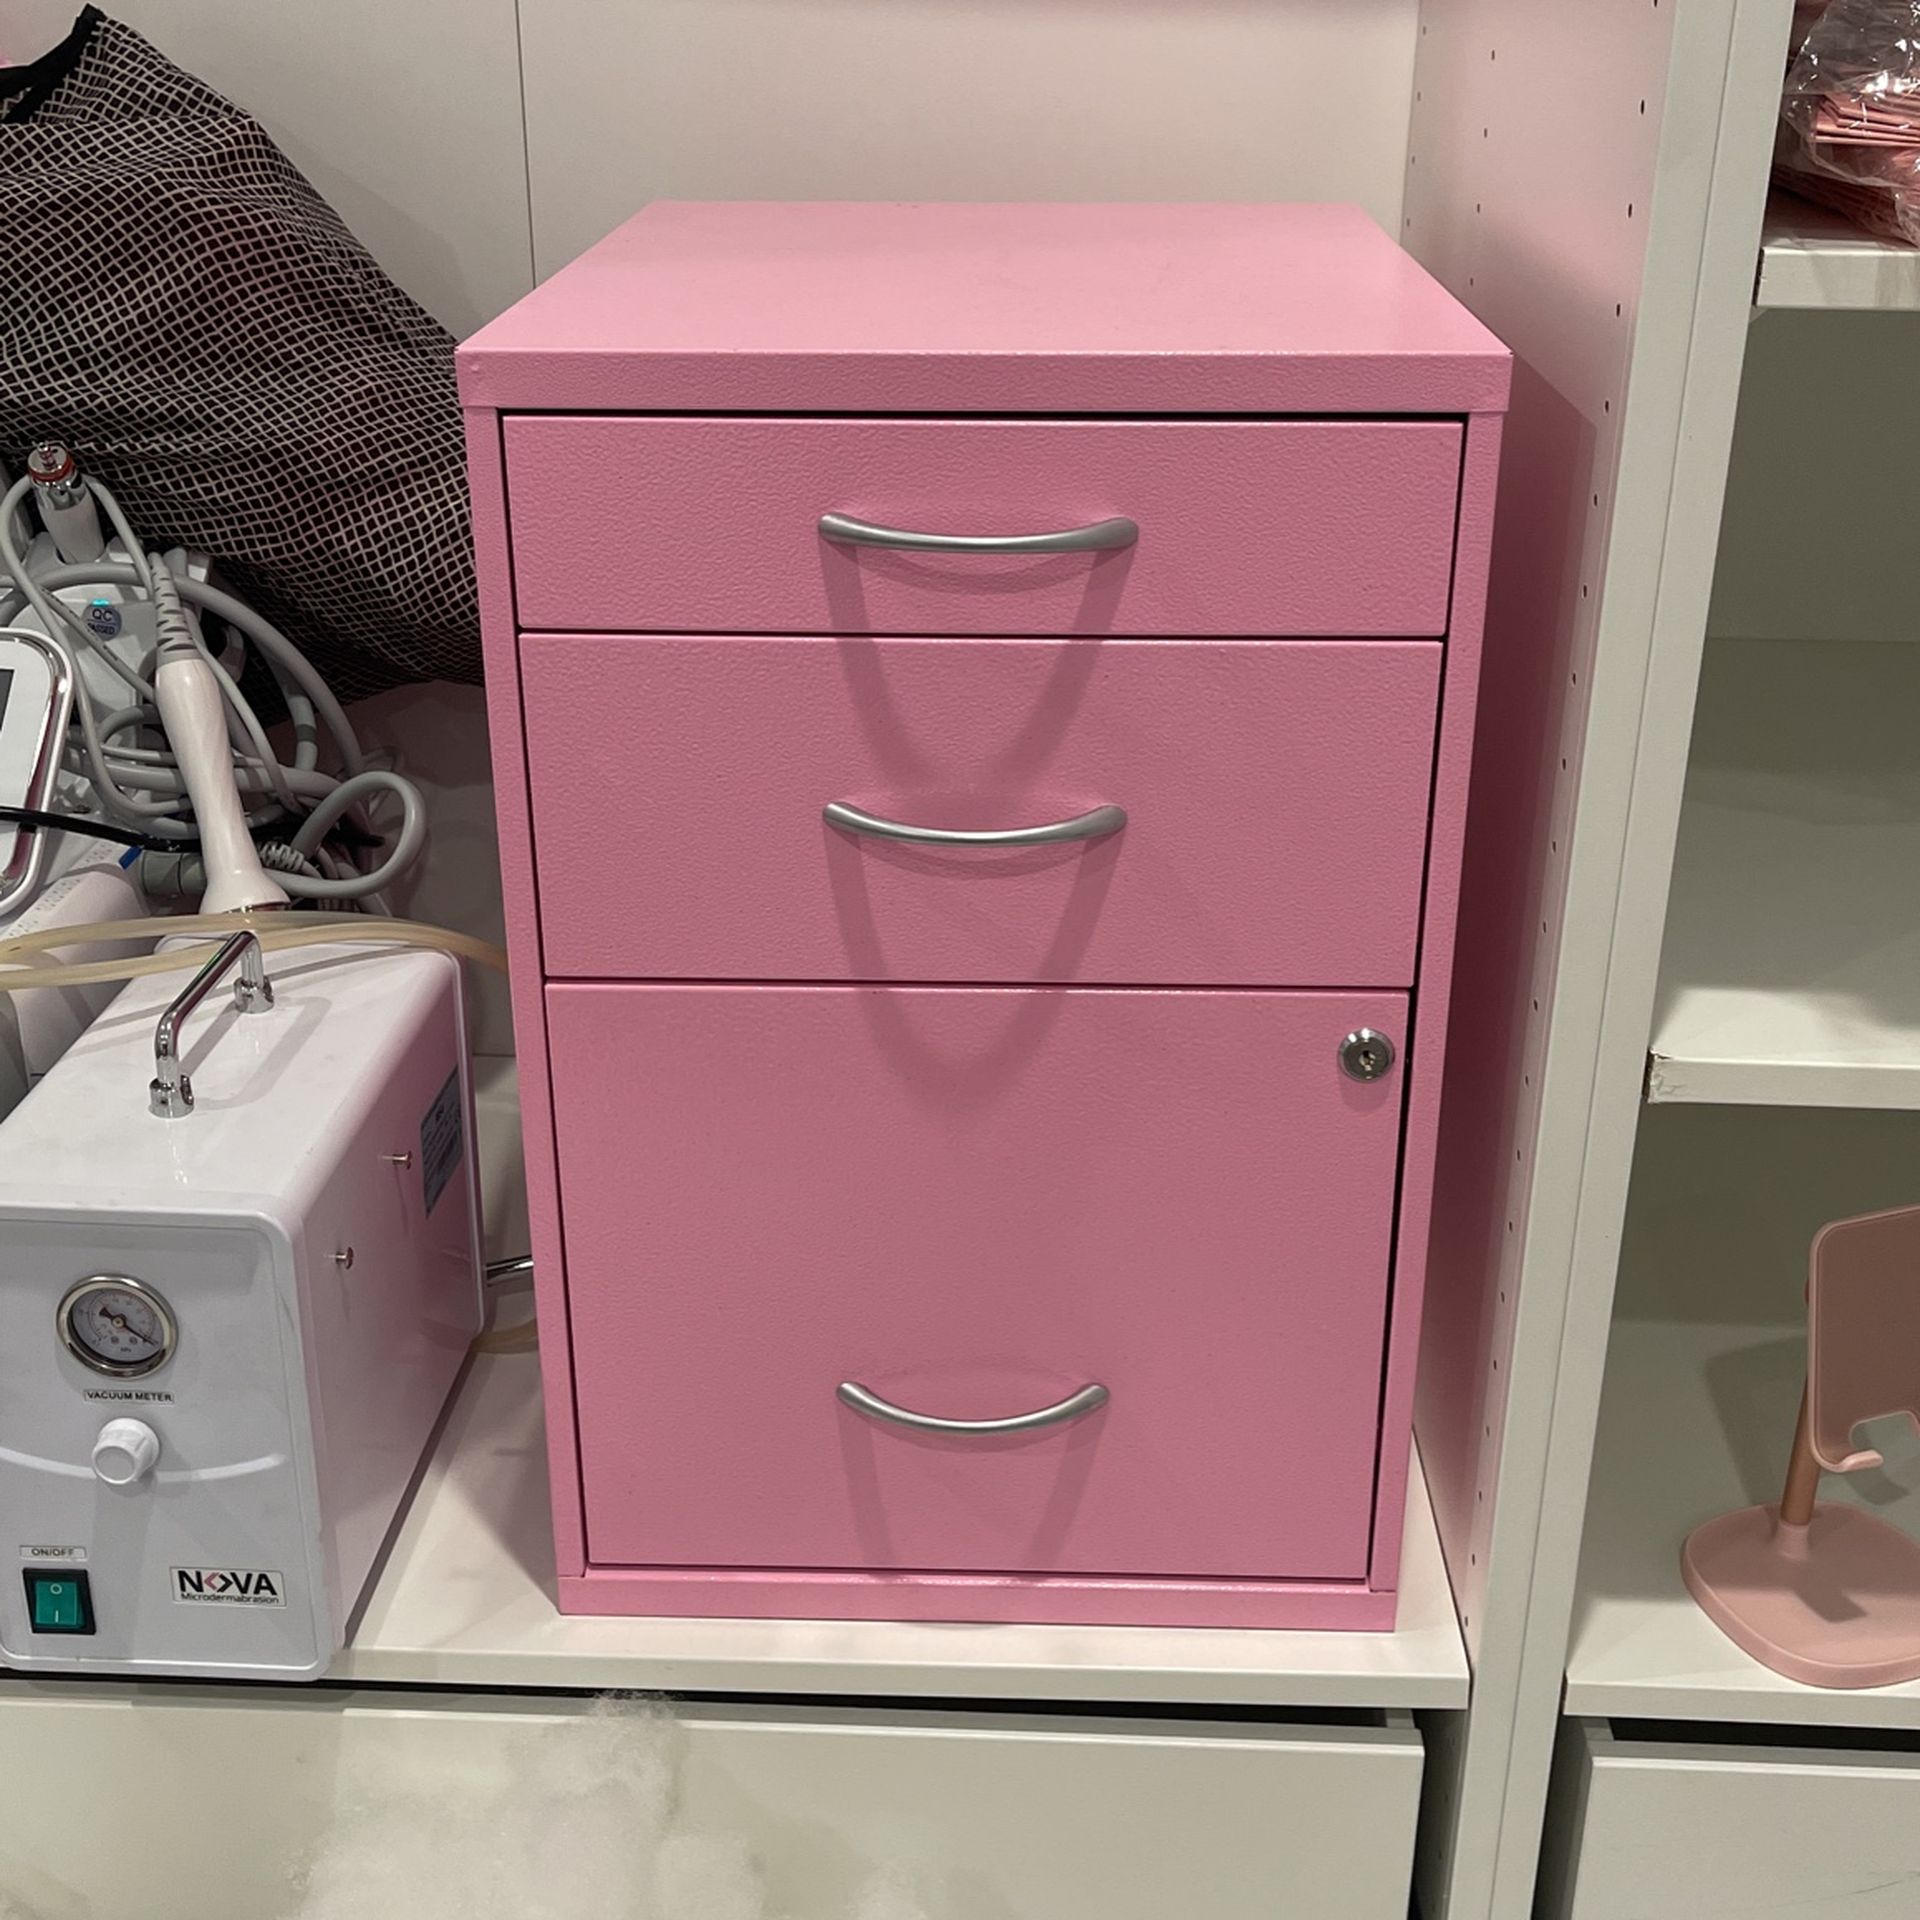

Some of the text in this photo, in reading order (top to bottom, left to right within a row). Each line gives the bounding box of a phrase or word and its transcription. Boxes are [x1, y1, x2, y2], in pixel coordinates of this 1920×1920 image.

[92, 608, 113, 621] QC
[87, 1391, 172, 1401] VACUUM METER
[31, 1548, 74, 1556] ON/OFF
[178, 1570, 277, 1595] NOVA
[181, 1593, 279, 1604] Microdermabrasion
